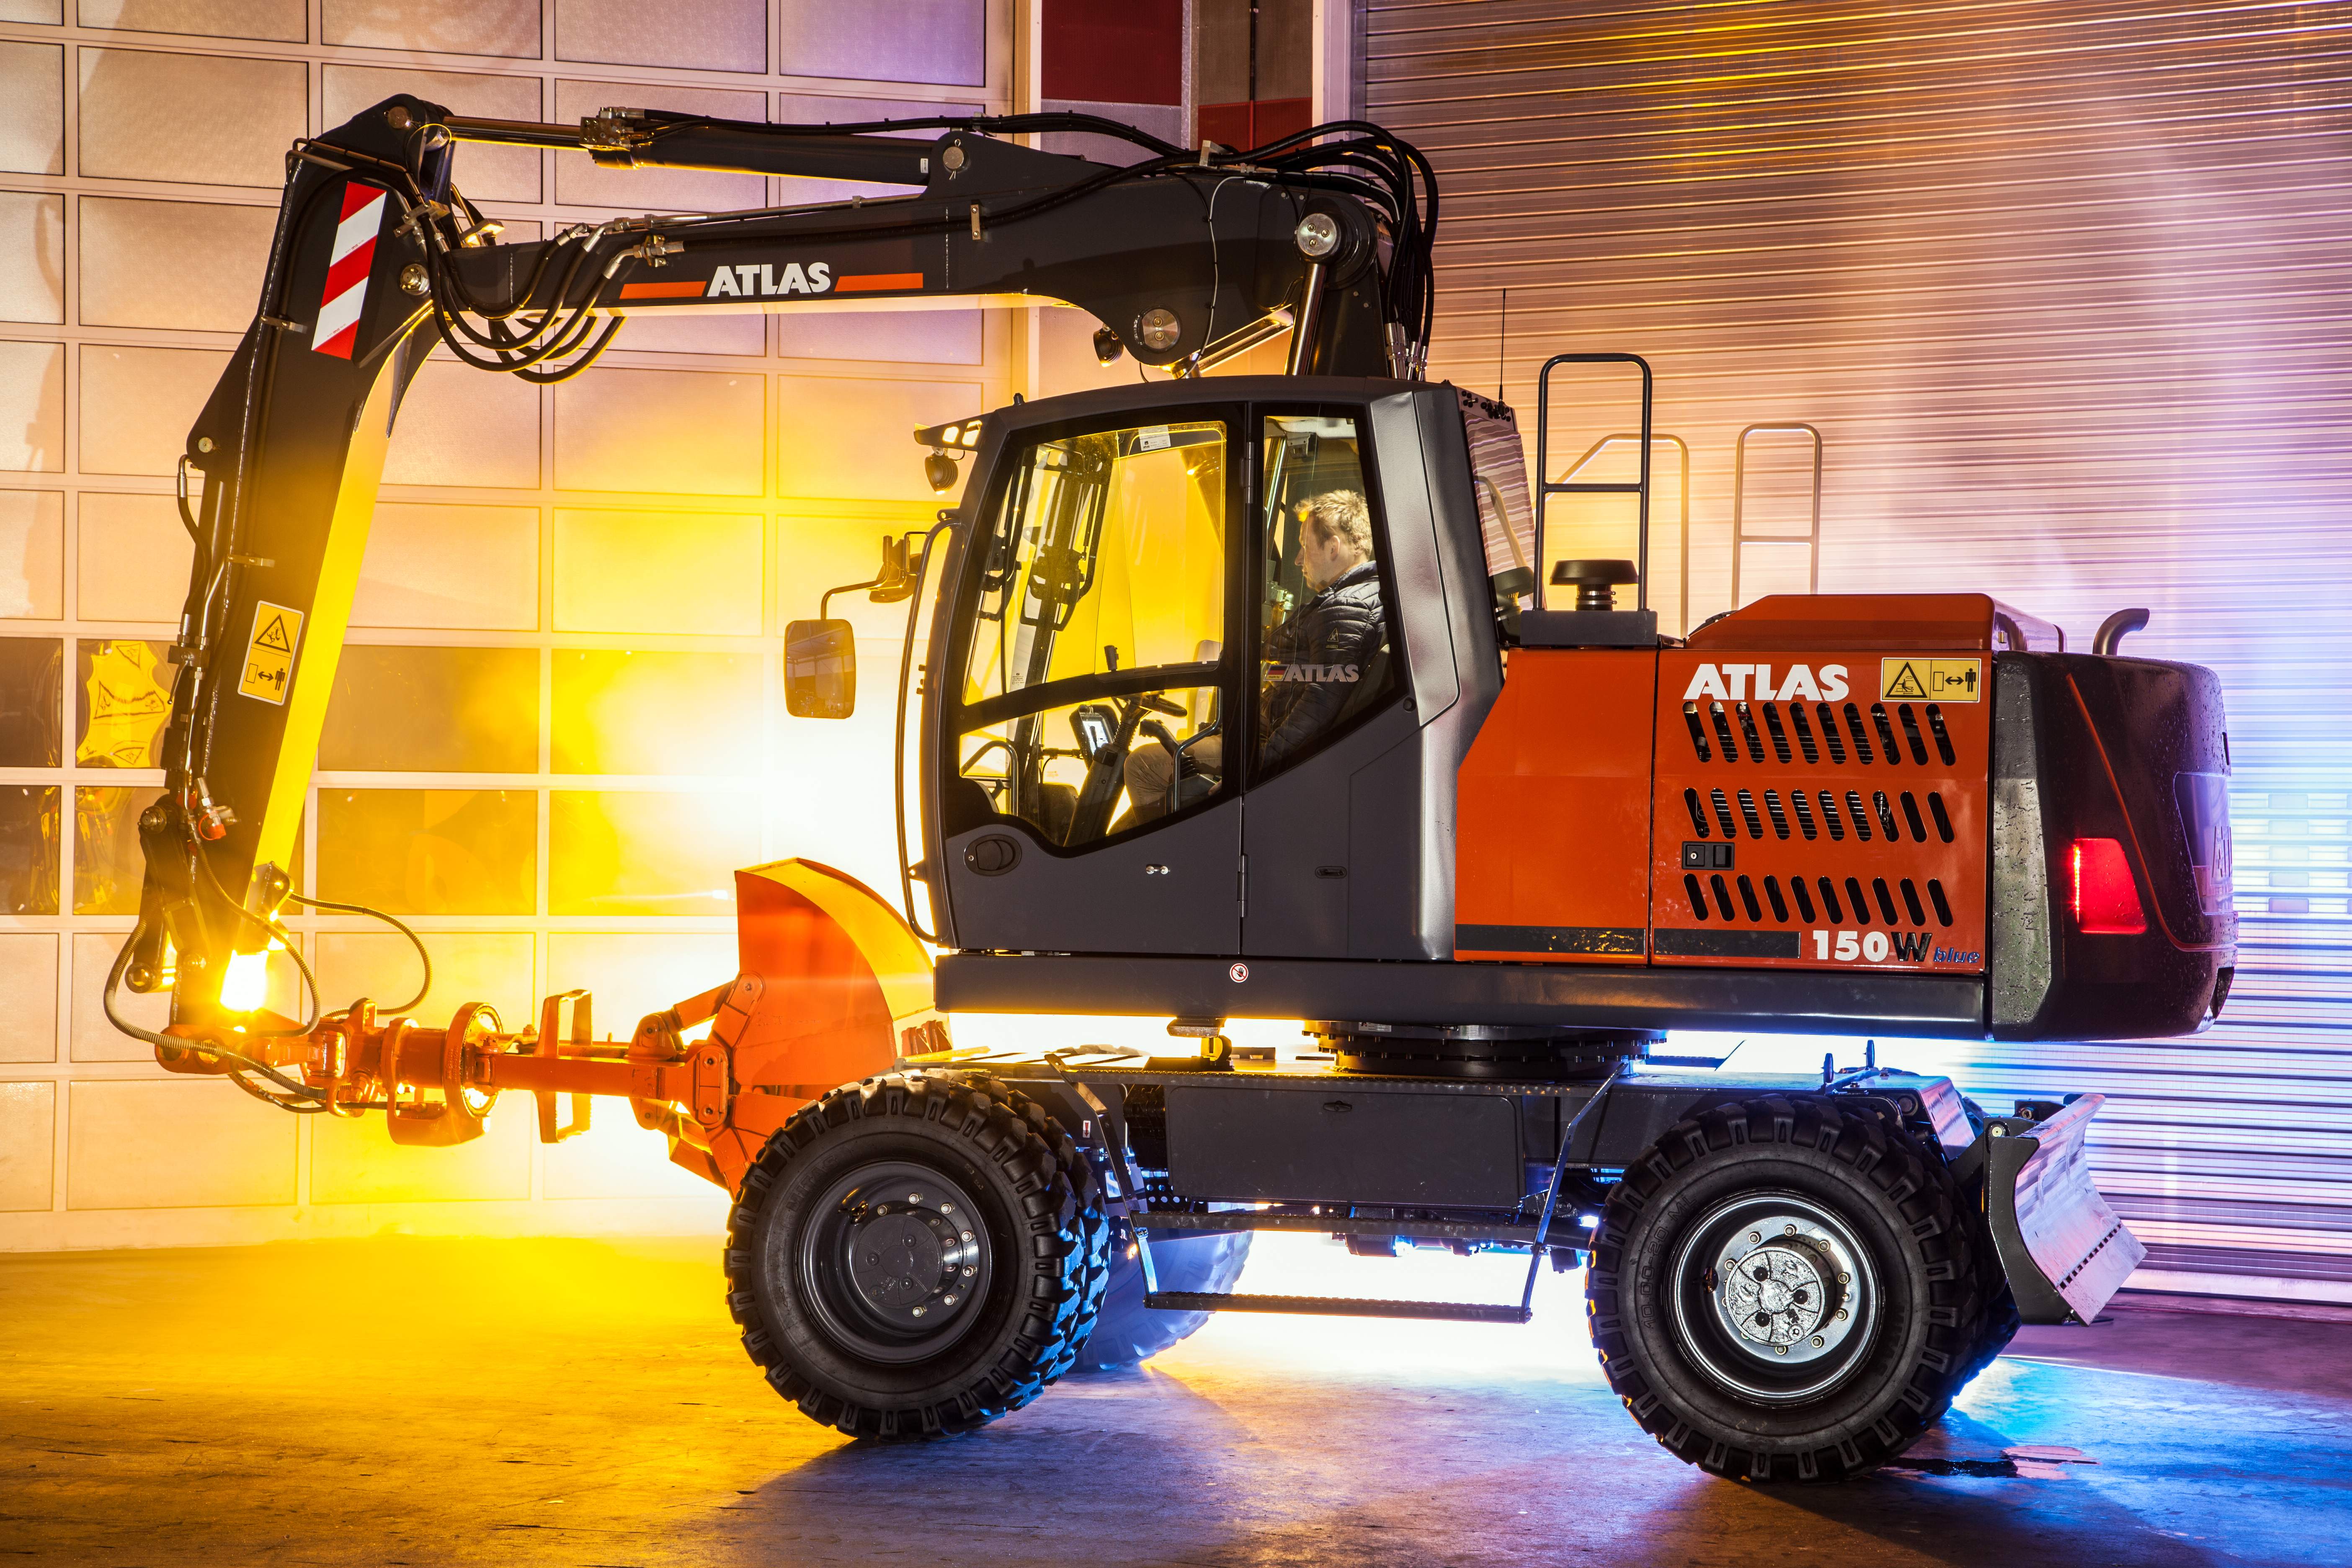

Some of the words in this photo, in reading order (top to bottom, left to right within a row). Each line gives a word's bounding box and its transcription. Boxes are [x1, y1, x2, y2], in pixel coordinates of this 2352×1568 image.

[707, 262, 831, 297] ATLAS
[1284, 664, 1359, 682] ATLAS
[1683, 663, 1849, 701] ATLAS
[1813, 930, 1933, 962] 150W
[1933, 946, 1981, 964] blue
[786, 1155, 838, 1213] MITAS
[1667, 1196, 1697, 1221] ML
